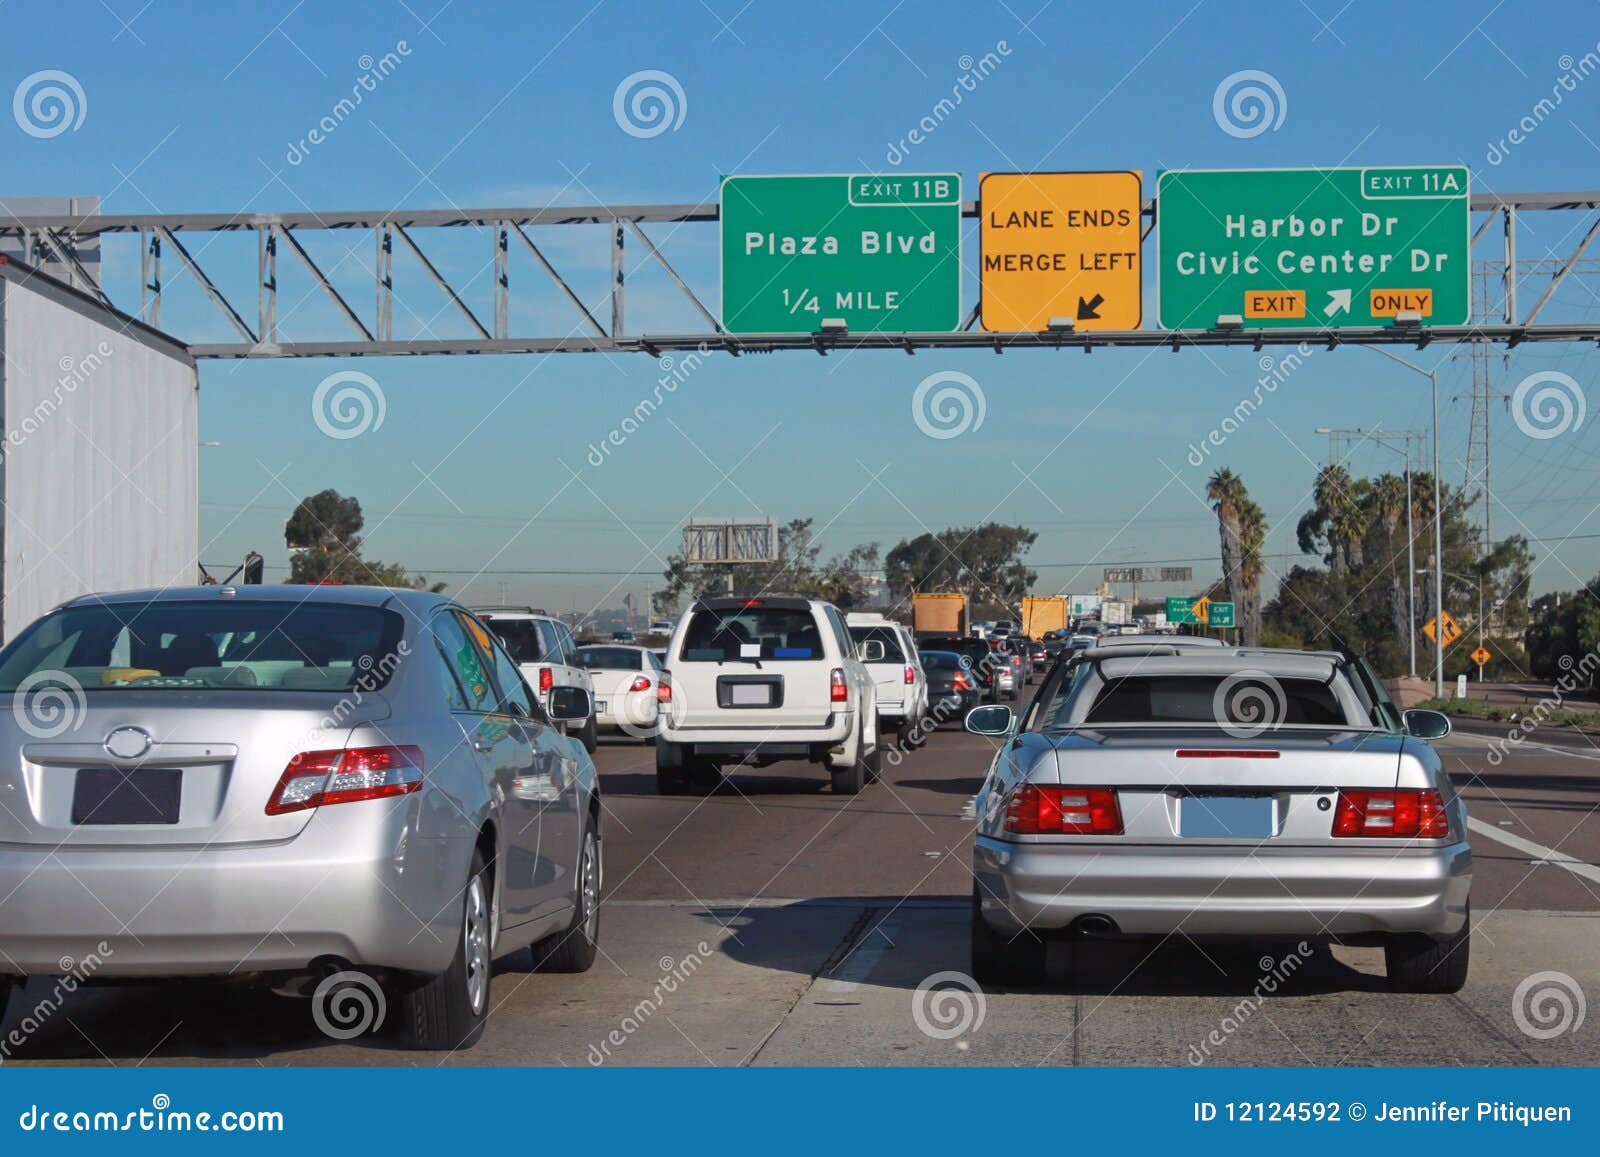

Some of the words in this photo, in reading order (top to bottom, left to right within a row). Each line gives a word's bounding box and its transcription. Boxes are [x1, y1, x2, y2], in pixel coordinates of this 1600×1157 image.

[860, 183, 901, 197] EXIT
[913, 180, 950, 199] 11B
[1370, 176, 1412, 190] EXIT
[1422, 173, 1459, 191] 11A
[991, 210, 1053, 229] LANE
[1068, 209, 1131, 228] ENDS
[1225, 213, 1344, 238] Harbor
[1362, 213, 1399, 236] Dr
[745, 232, 839, 255] Plaza
[861, 230, 936, 254] Blvd
[985, 253, 1067, 272] MERGE
[1080, 252, 1137, 271] LEFT
[1177, 251, 1259, 276] Civic
[1277, 249, 1392, 274] Center
[1411, 249, 1448, 273] Dr
[782, 288, 820, 314] 1/4
[836, 291, 899, 311] MILE
[1252, 296, 1297, 312] EXIT
[1373, 295, 1429, 311] ONLY
